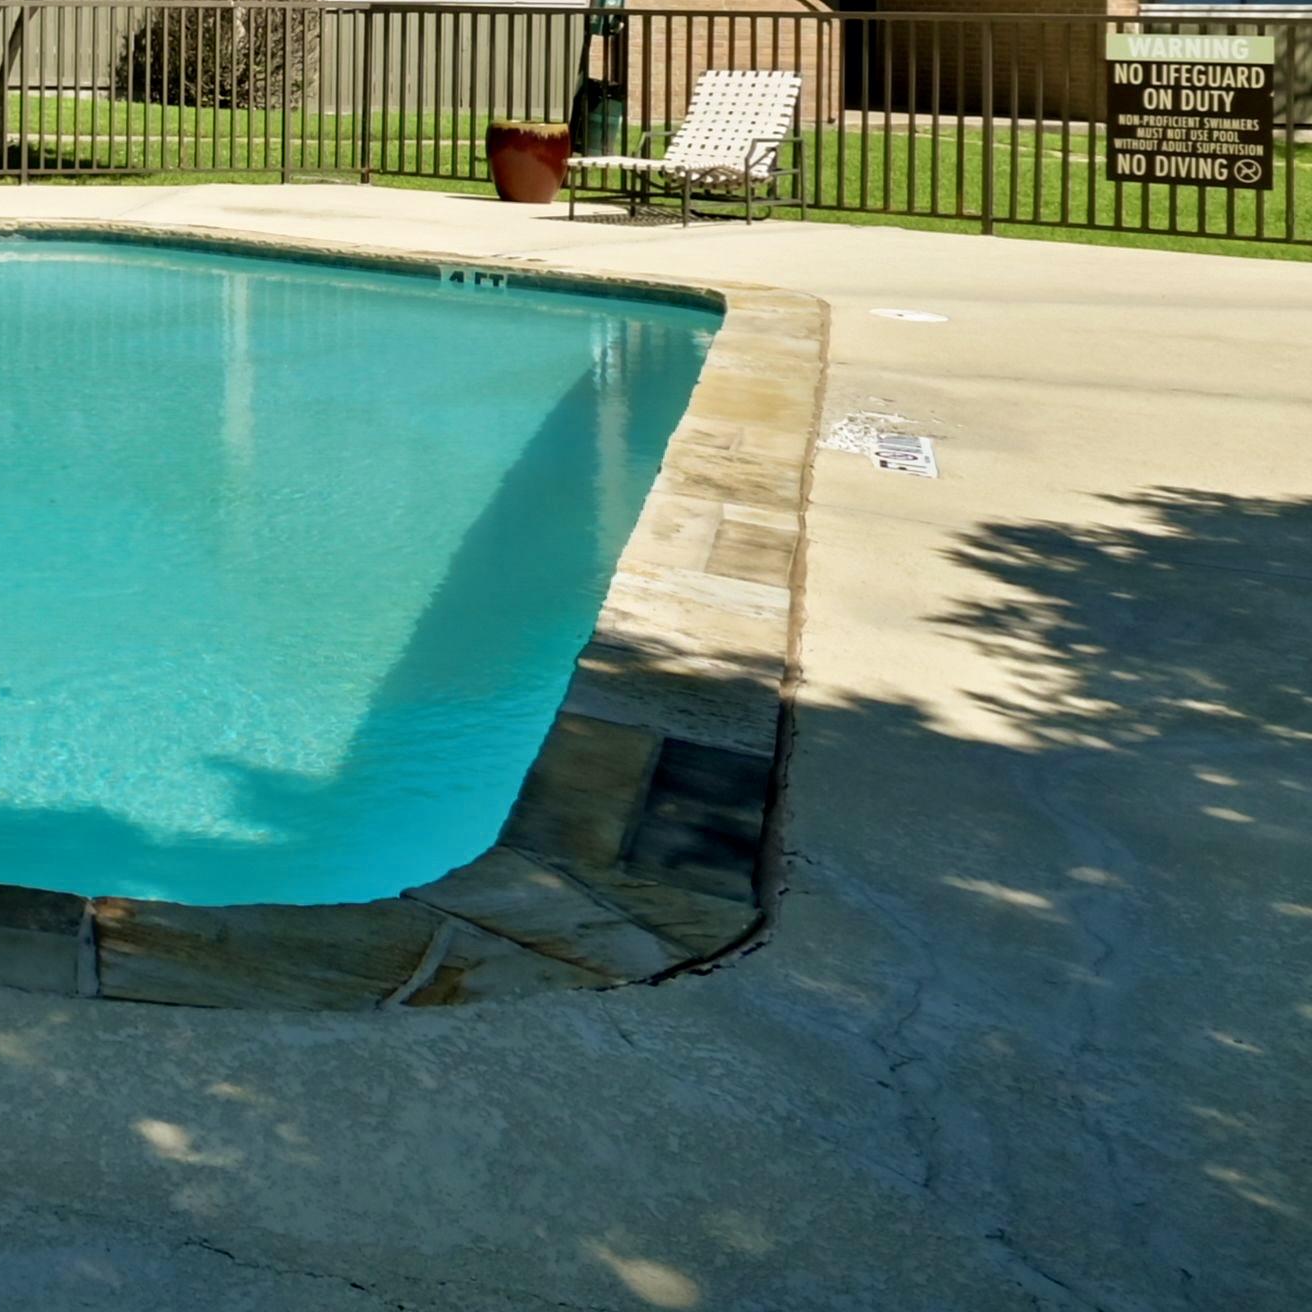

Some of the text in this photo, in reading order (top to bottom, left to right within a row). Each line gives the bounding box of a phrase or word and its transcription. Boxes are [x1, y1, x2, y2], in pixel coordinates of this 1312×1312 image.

[1128, 37, 1249, 59] WARNING
[1114, 63, 1265, 89] NO LIFEGUARD
[1143, 88, 1235, 113] ON DUTY
[1118, 114, 1260, 131] NON-PROFICIENT SWIMMERS
[1136, 128, 1240, 143] MUST NOT USE POOL
[1114, 139, 1264, 156] WITHOUT ADULT SUPERVISION
[1117, 153, 1229, 181] NO DIVING
